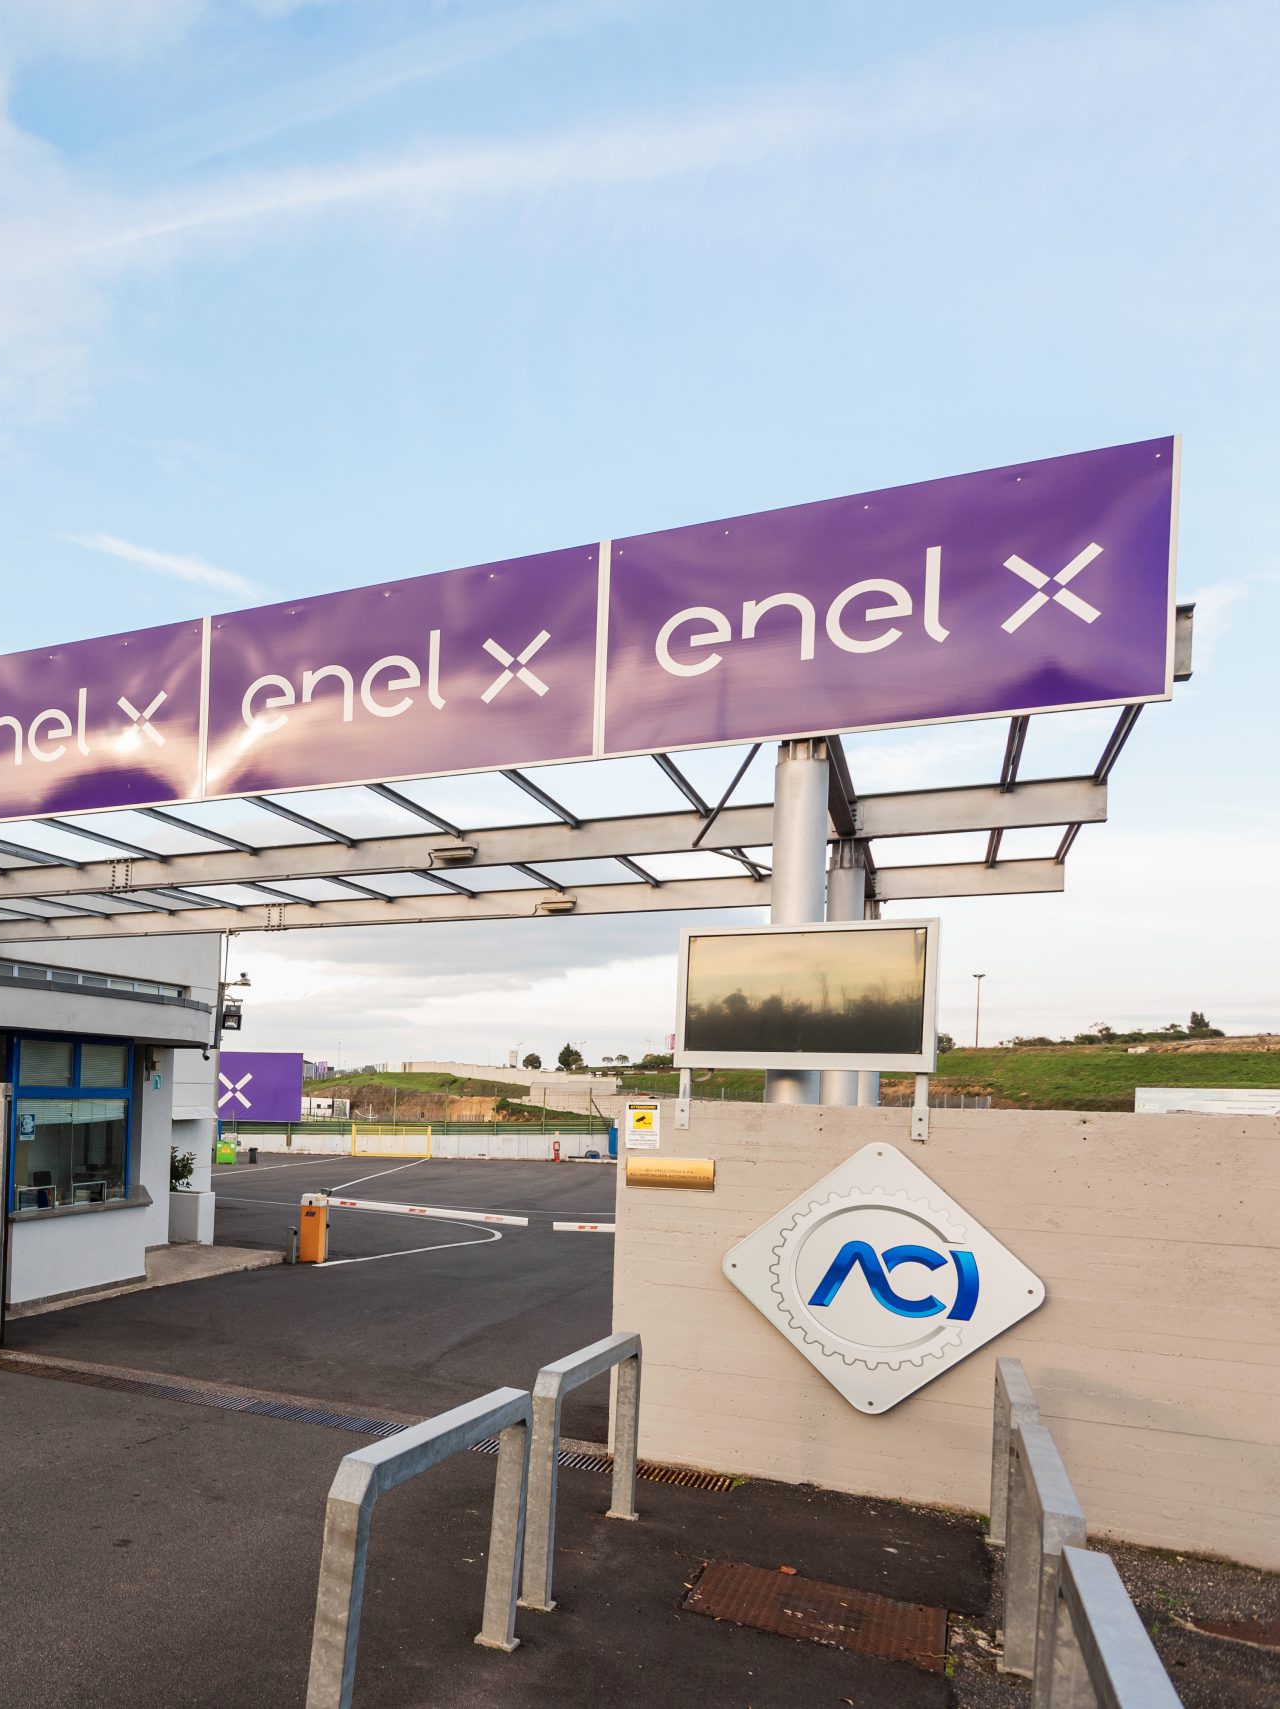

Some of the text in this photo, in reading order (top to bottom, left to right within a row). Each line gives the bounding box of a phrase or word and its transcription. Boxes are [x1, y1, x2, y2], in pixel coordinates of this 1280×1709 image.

[654, 545, 951, 677] enel
[240, 628, 446, 734] enel
[807, 1240, 980, 1322] ACI
